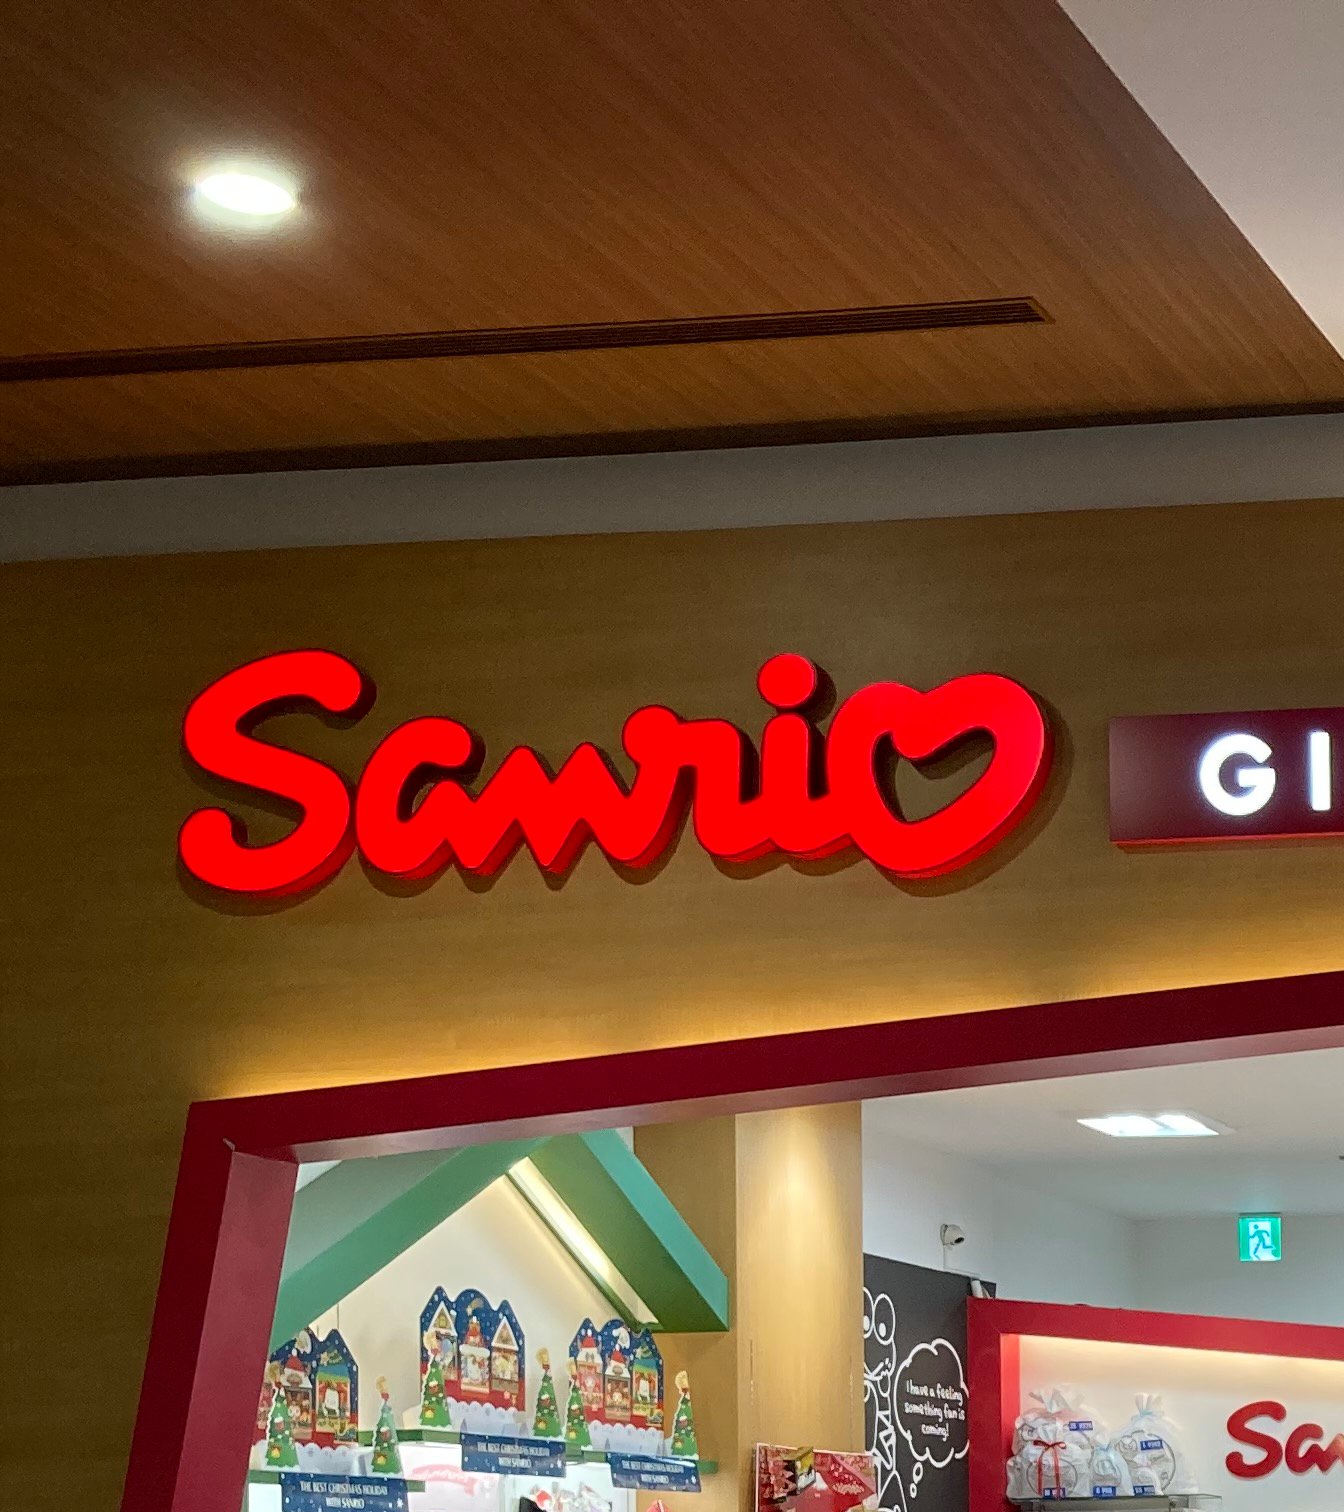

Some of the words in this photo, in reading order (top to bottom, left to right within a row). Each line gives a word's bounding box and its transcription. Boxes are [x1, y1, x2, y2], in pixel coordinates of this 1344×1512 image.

[178, 648, 1056, 899] Sanrio
[936, 1383, 963, 1406] feeling
[904, 1401, 943, 1422] something
